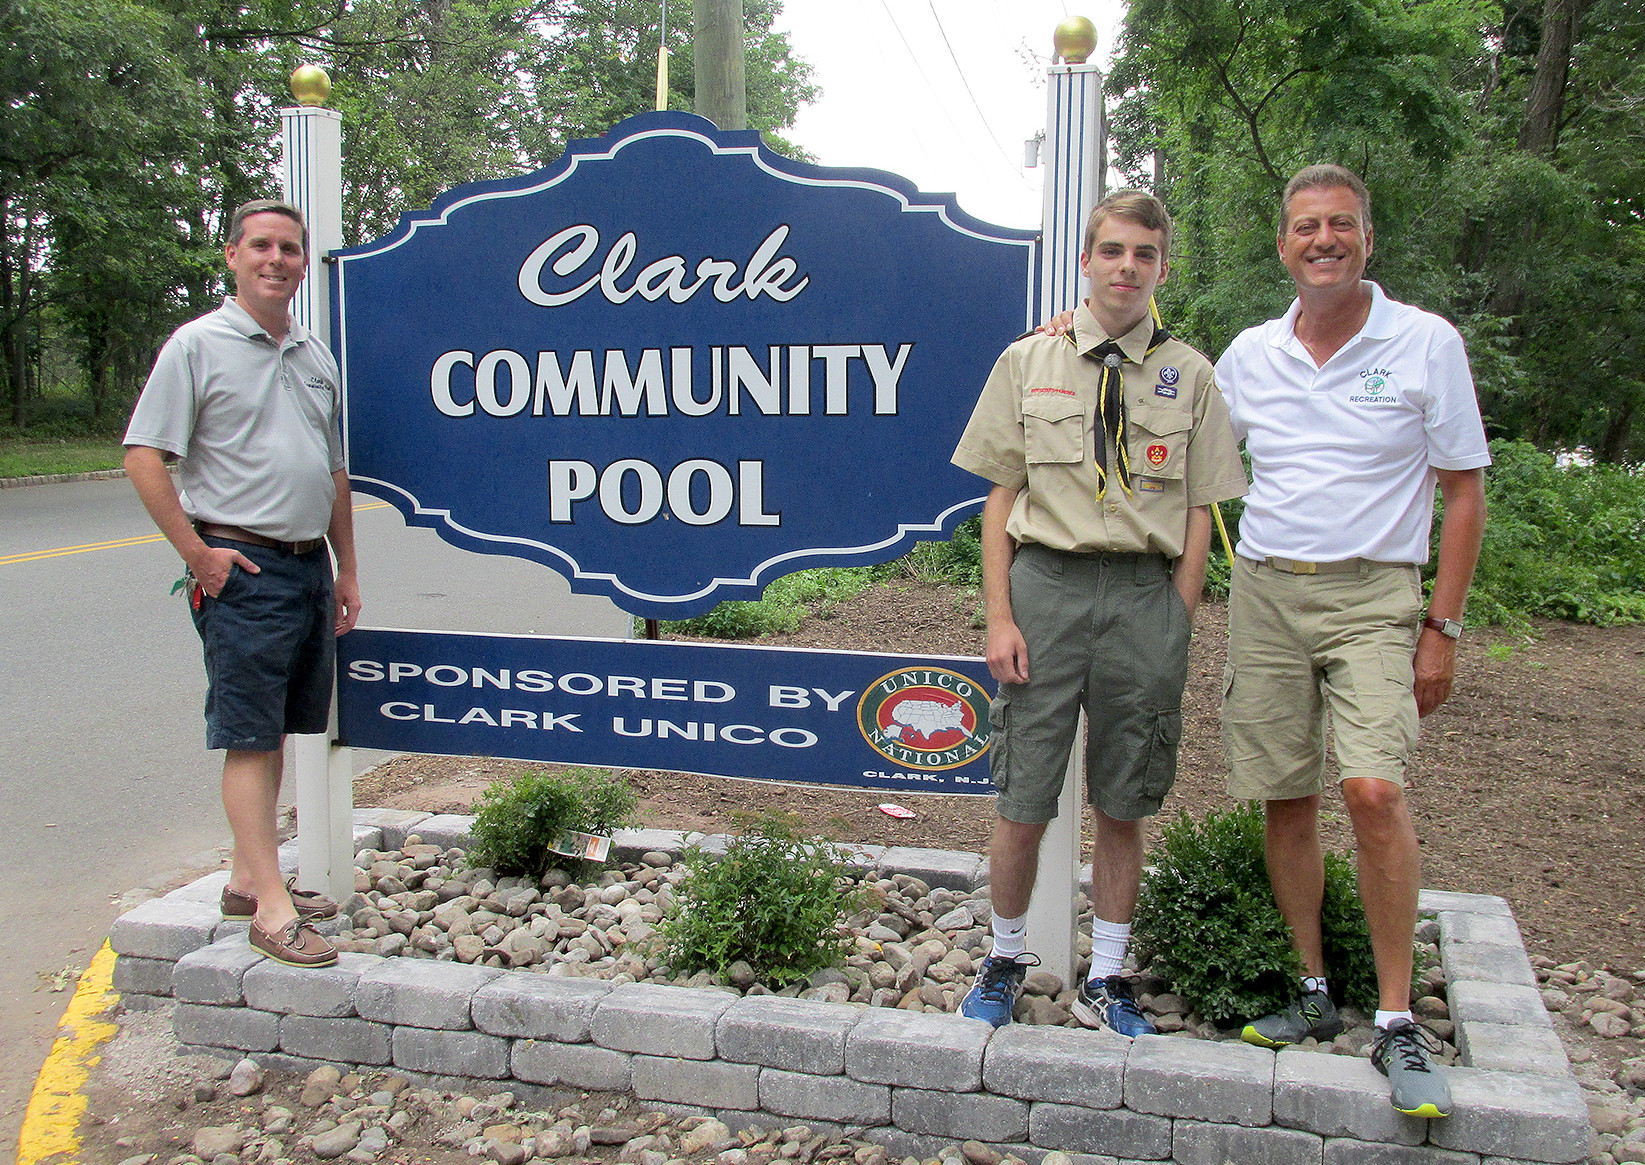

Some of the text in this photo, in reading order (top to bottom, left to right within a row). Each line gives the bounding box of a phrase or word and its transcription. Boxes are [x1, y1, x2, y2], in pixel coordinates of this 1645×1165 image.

[518, 224, 809, 306] Clark
[430, 343, 914, 417] COMMUNITY
[1359, 367, 1393, 379] CLARK
[1349, 395, 1397, 403] RECREATION
[548, 459, 782, 526] POOL
[347, 659, 856, 712] SPONSORED BY
[880, 671, 973, 698] UNICO
[379, 701, 819, 749] CLARK UNICO
[867, 727, 990, 766] NATIONAL
[862, 770, 996, 786] CLARK, N.J.
